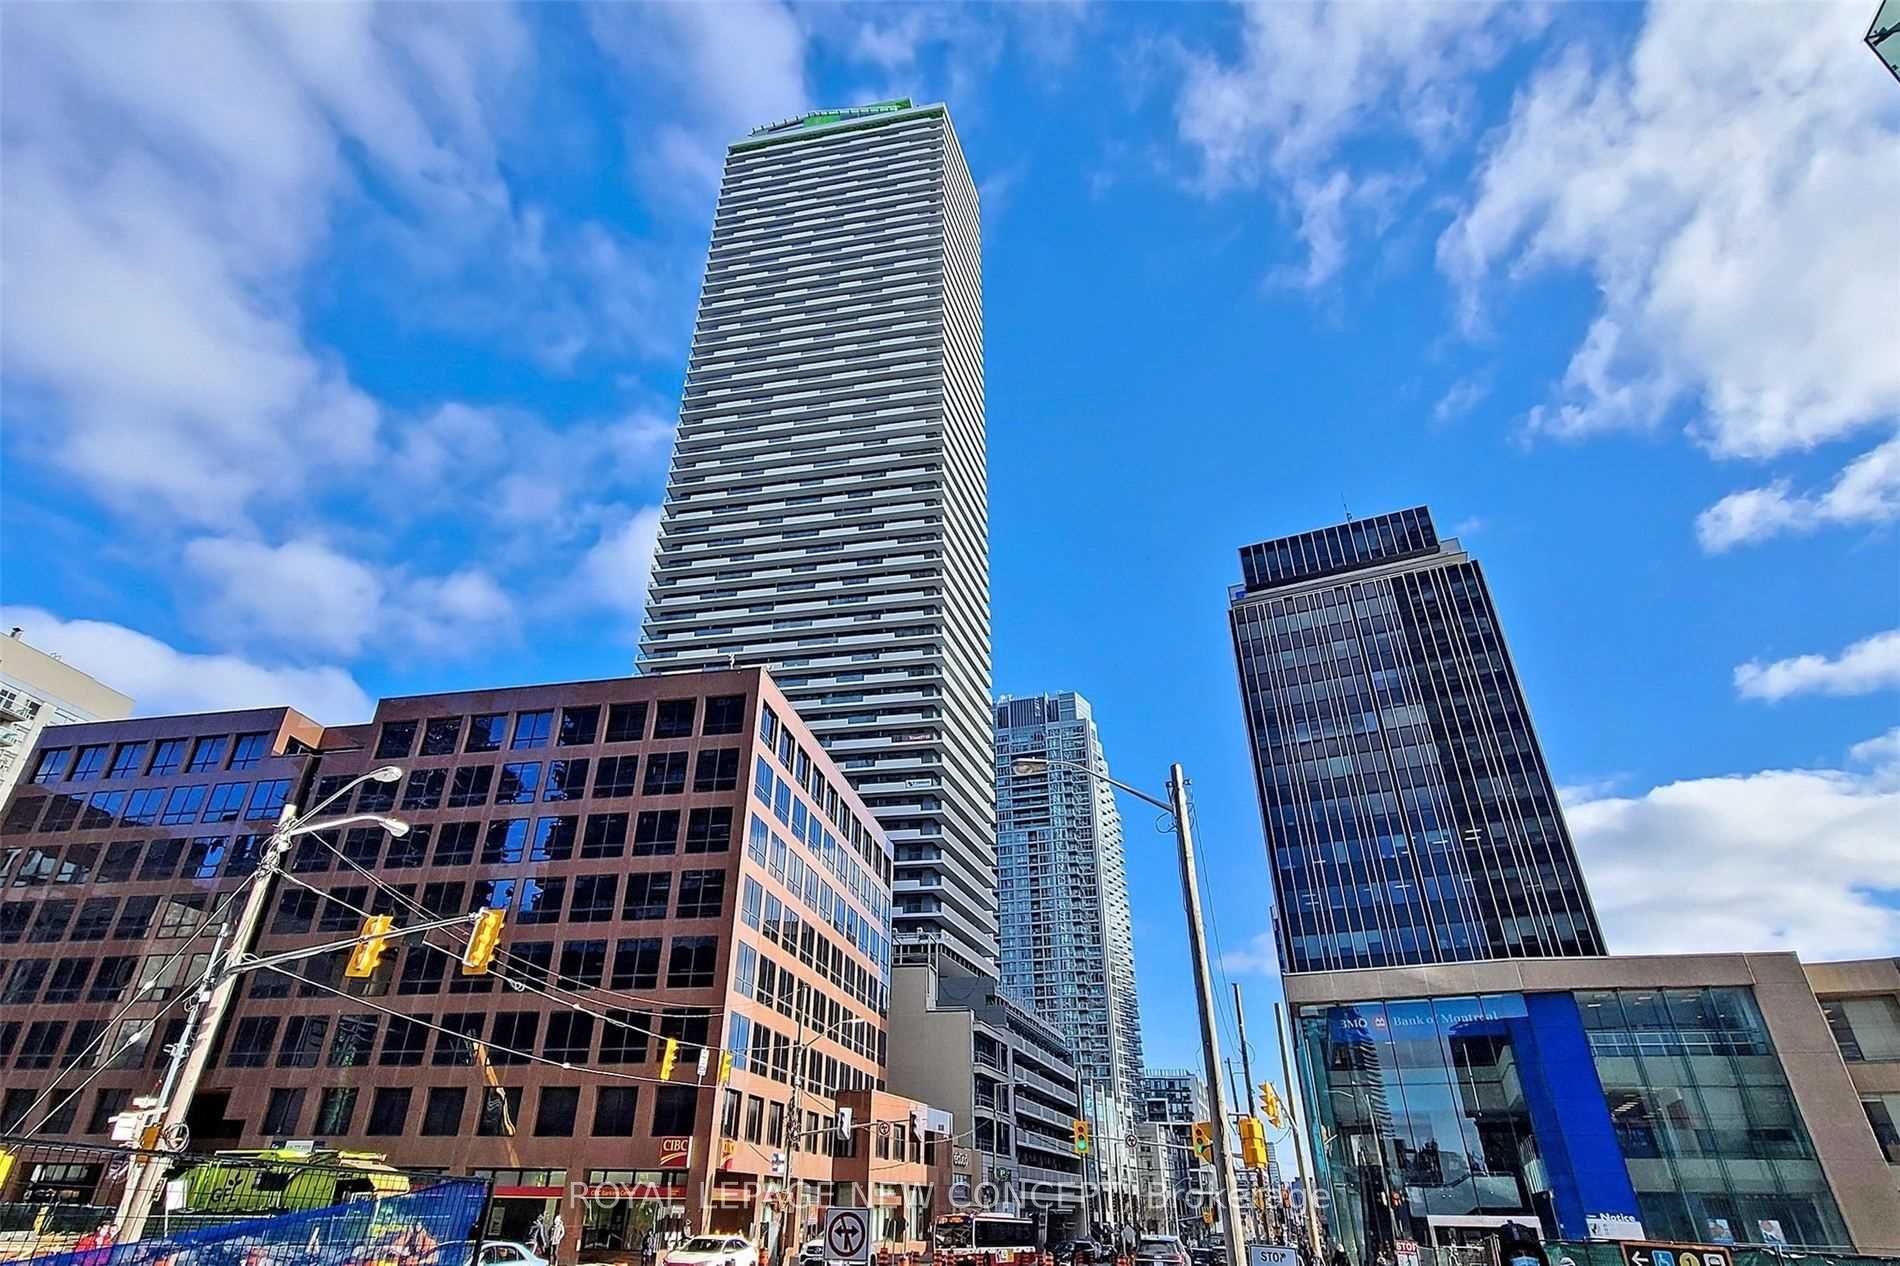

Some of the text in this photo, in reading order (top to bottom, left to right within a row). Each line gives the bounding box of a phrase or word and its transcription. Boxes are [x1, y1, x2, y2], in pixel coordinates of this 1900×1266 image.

[1393, 1015, 1424, 1026] Bank
[1441, 1010, 1499, 1024] Montreal
[663, 1139, 689, 1152] CIBC
[1599, 1212, 1636, 1222] Notice
[1260, 1251, 1287, 1263] STOP
